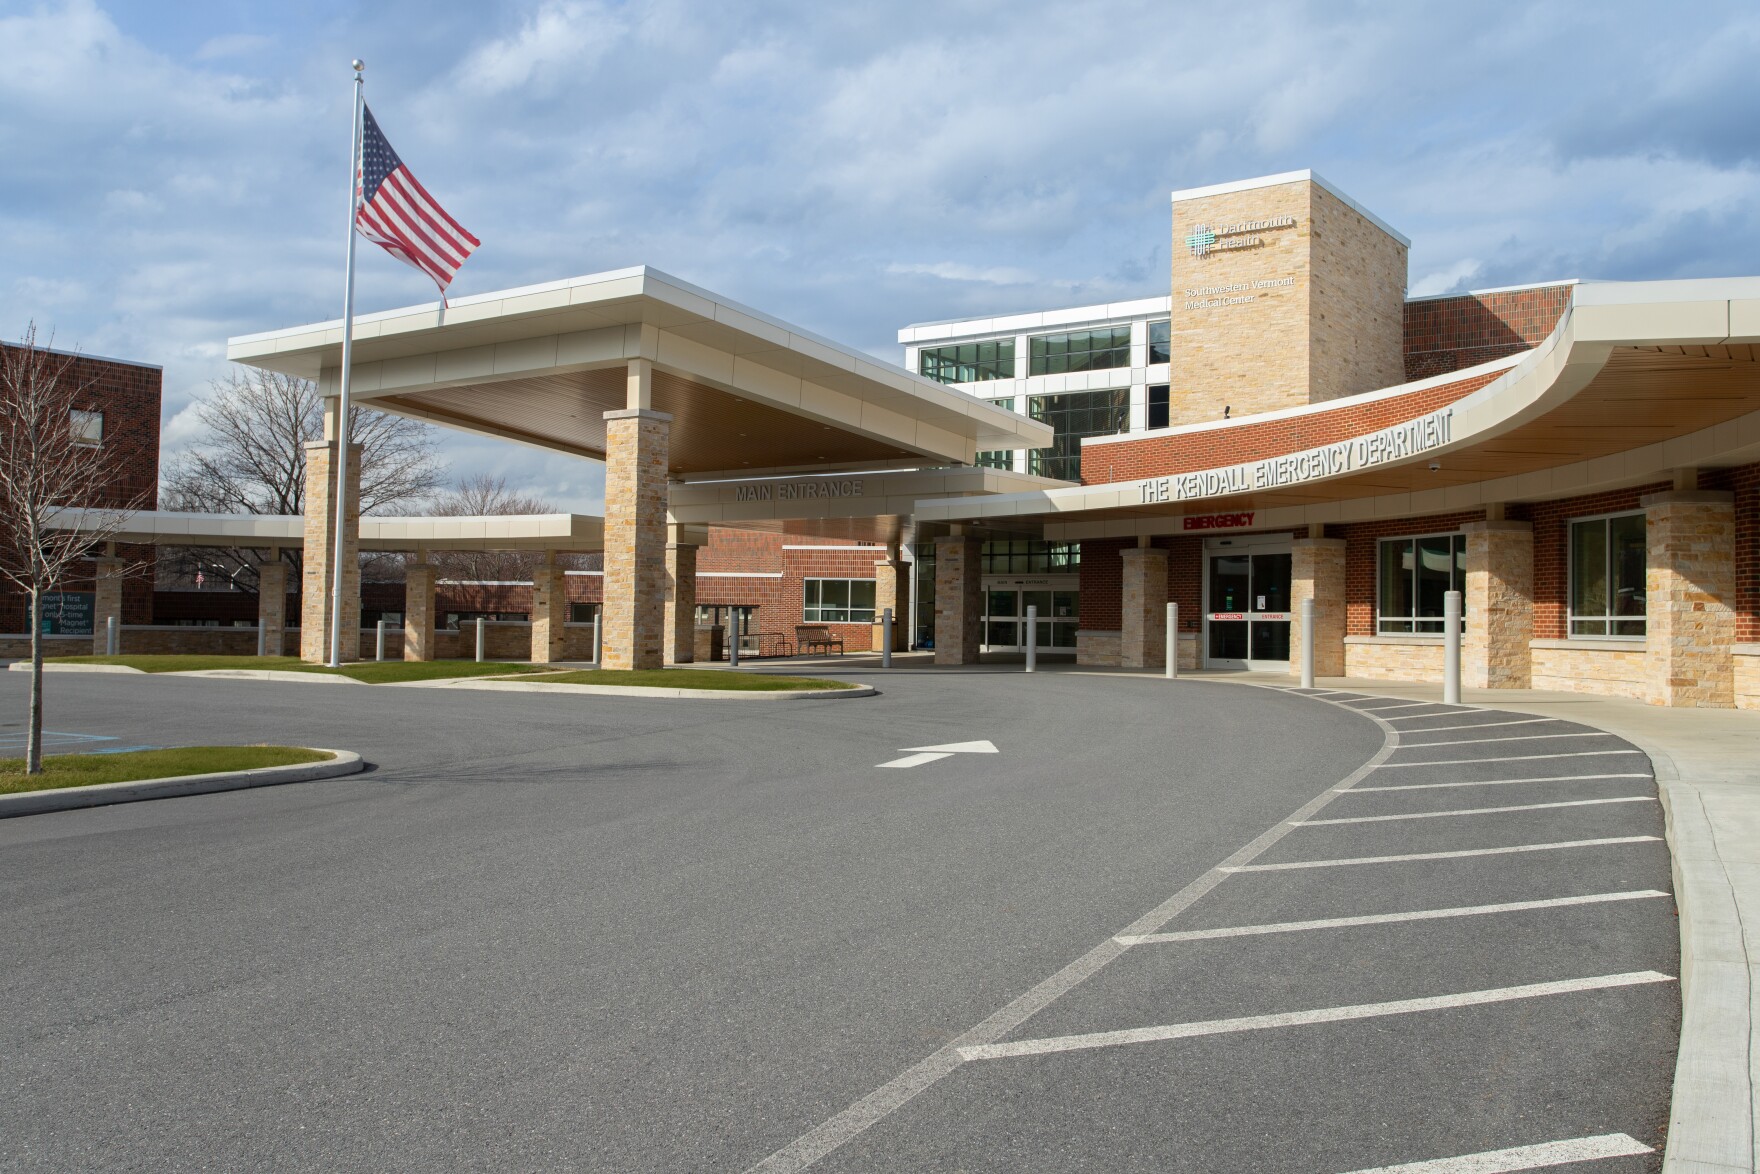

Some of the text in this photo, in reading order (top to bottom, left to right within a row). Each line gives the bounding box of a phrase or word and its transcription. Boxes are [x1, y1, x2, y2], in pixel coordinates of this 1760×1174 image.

[1220, 215, 1293, 234] Dartmouth
[1220, 235, 1261, 249] Health
[1185, 276, 1294, 297] Southwestern Vermont
[1185, 294, 1255, 310] Medical Center
[1138, 409, 1453, 503] THE KENDALL EMERGENCY DEPARTMENT
[736, 480, 863, 501] MAIN ENTRANCE
[1184, 512, 1255, 530] EMERGENCY
